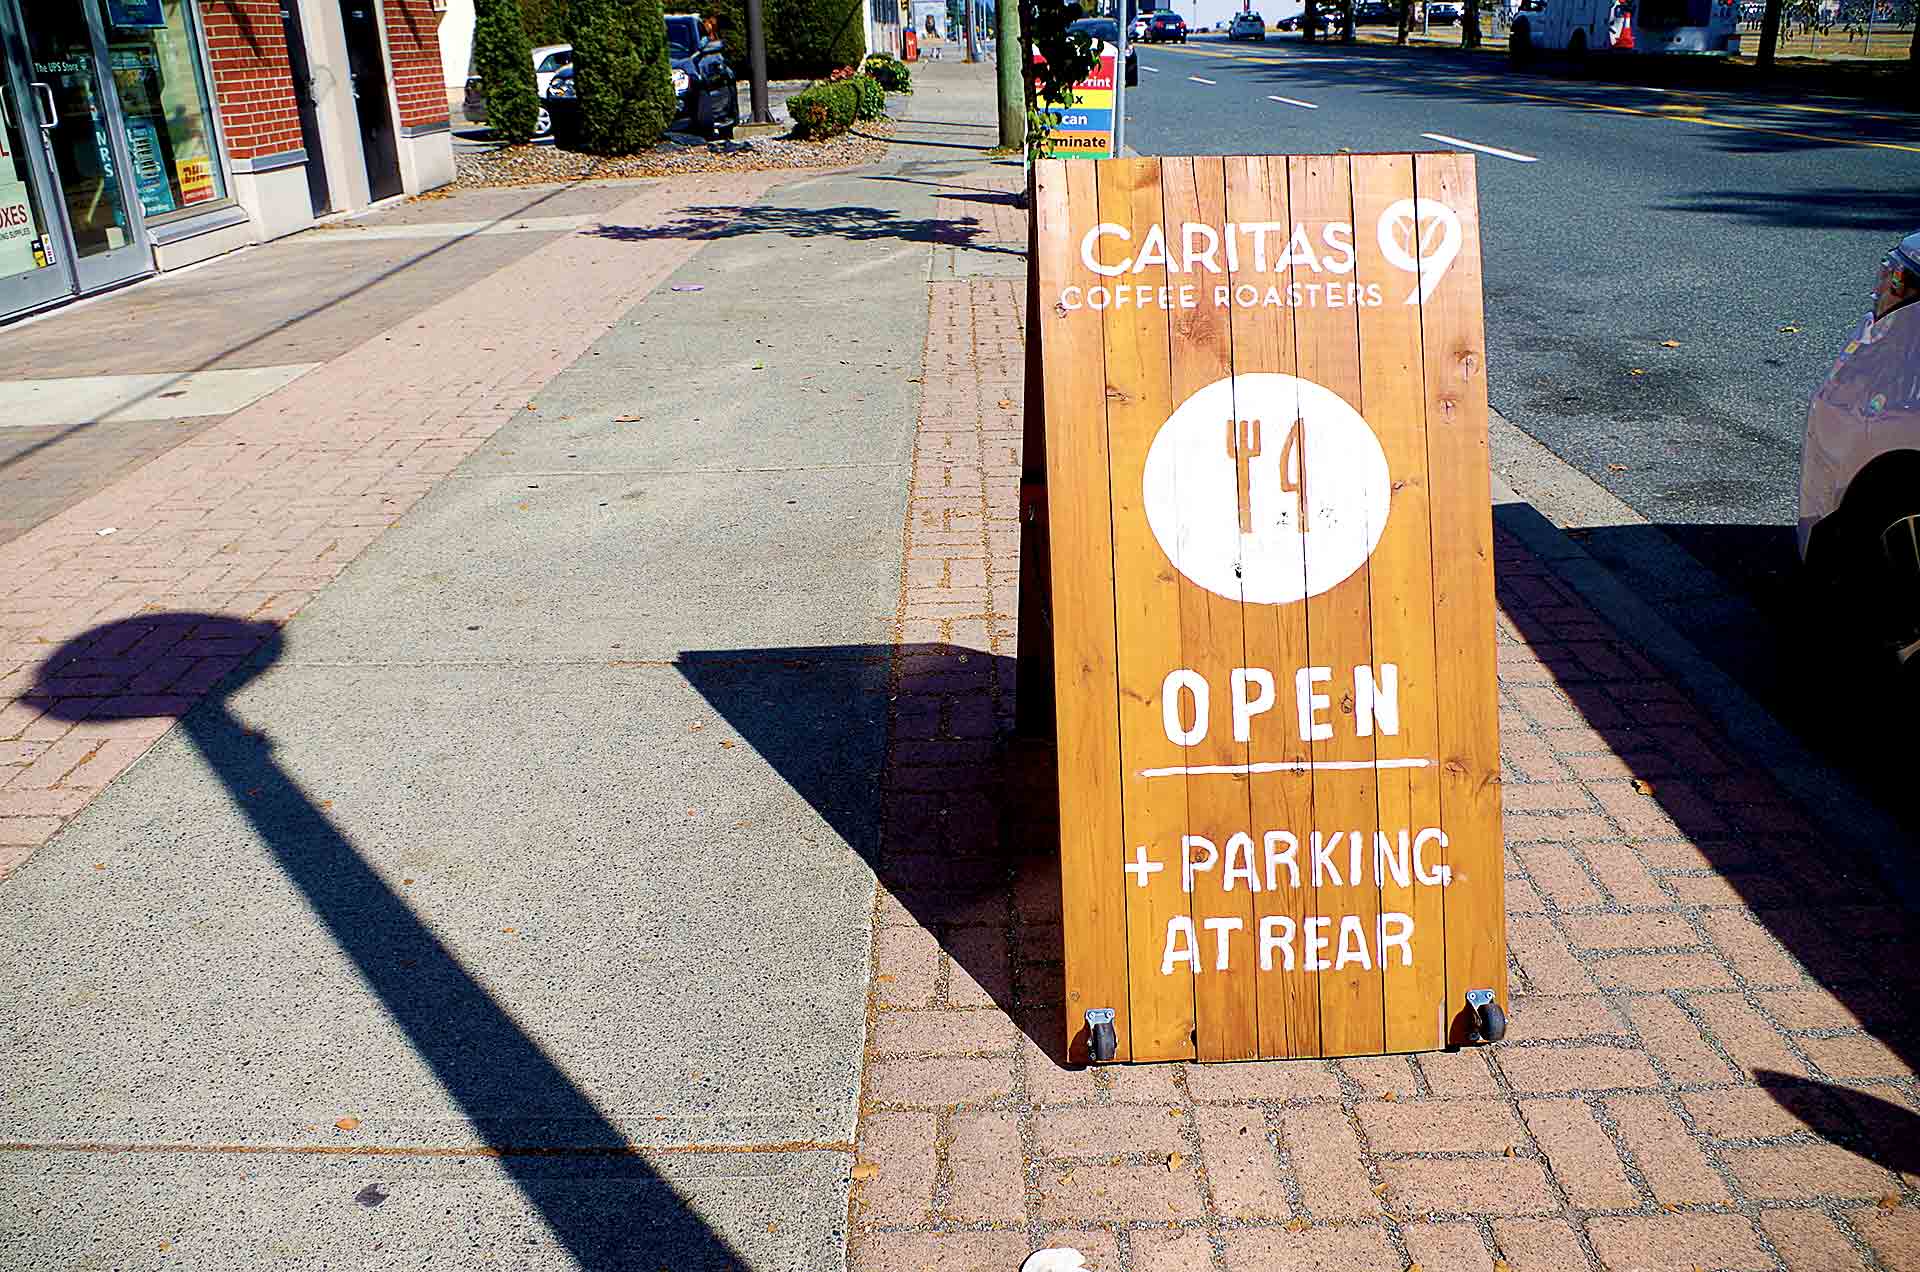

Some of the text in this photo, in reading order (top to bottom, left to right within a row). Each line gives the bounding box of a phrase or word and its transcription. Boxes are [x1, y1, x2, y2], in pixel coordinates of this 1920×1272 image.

[33, 61, 79, 72] The UPS Store
[1083, 77, 1111, 88] rint
[1061, 114, 1089, 125] can
[1045, 136, 1107, 148] minate
[1080, 221, 1356, 277] CARITAS
[1060, 282, 1383, 312] COFFEE ROASTERS
[1162, 663, 1400, 747] OPEN
[1181, 827, 1453, 893] PARKING
[1160, 912, 1415, 975] AT REAR
